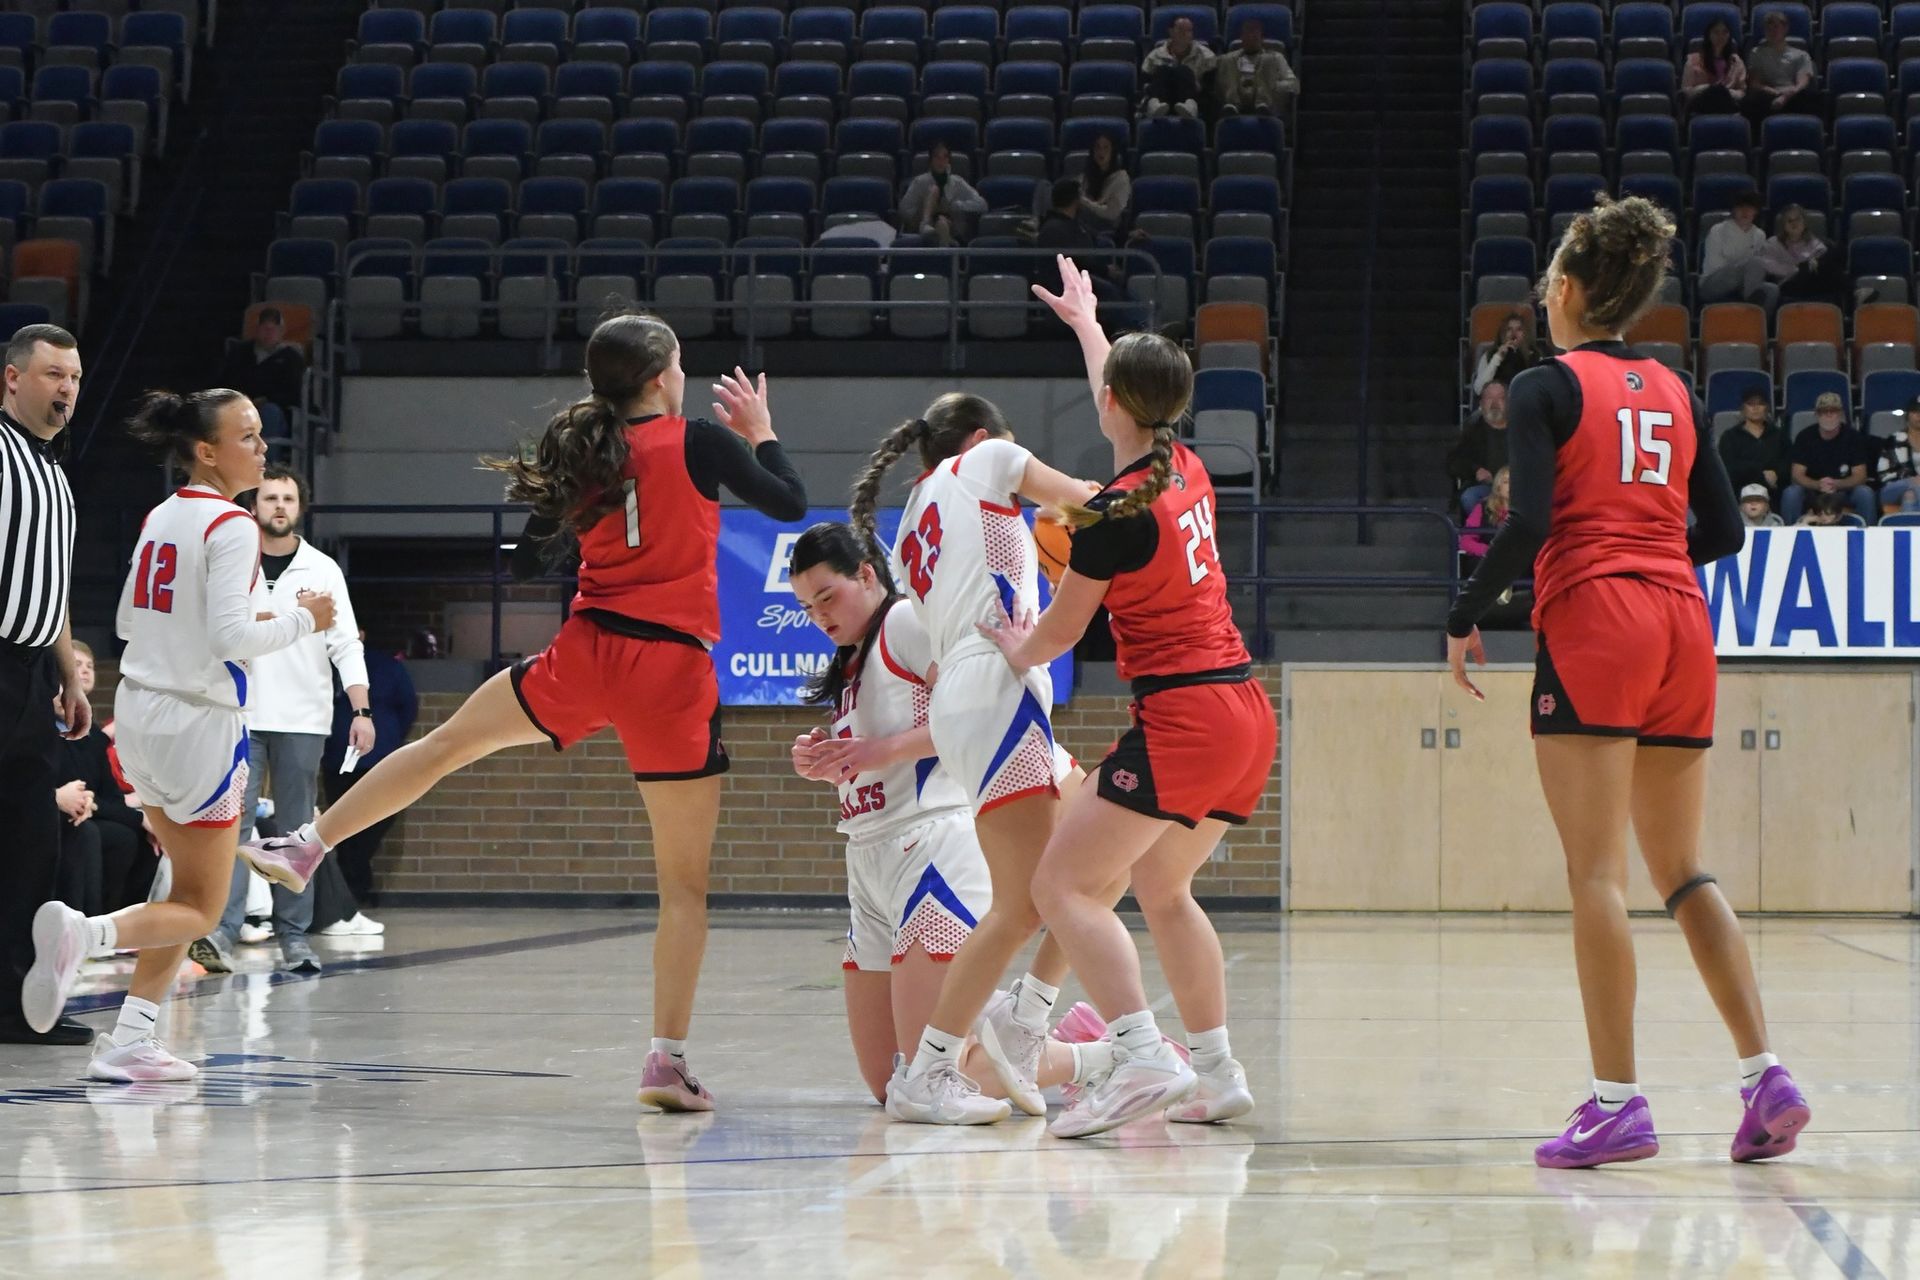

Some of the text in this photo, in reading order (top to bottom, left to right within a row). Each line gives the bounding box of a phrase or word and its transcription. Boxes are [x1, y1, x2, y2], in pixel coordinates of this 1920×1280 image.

[1616, 407, 1673, 486] 15
[622, 478, 641, 549] 1
[1177, 495, 1220, 587] 24
[133, 540, 178, 614] 12
[901, 501, 943, 605] 23
[730, 652, 837, 677] CULLMA
